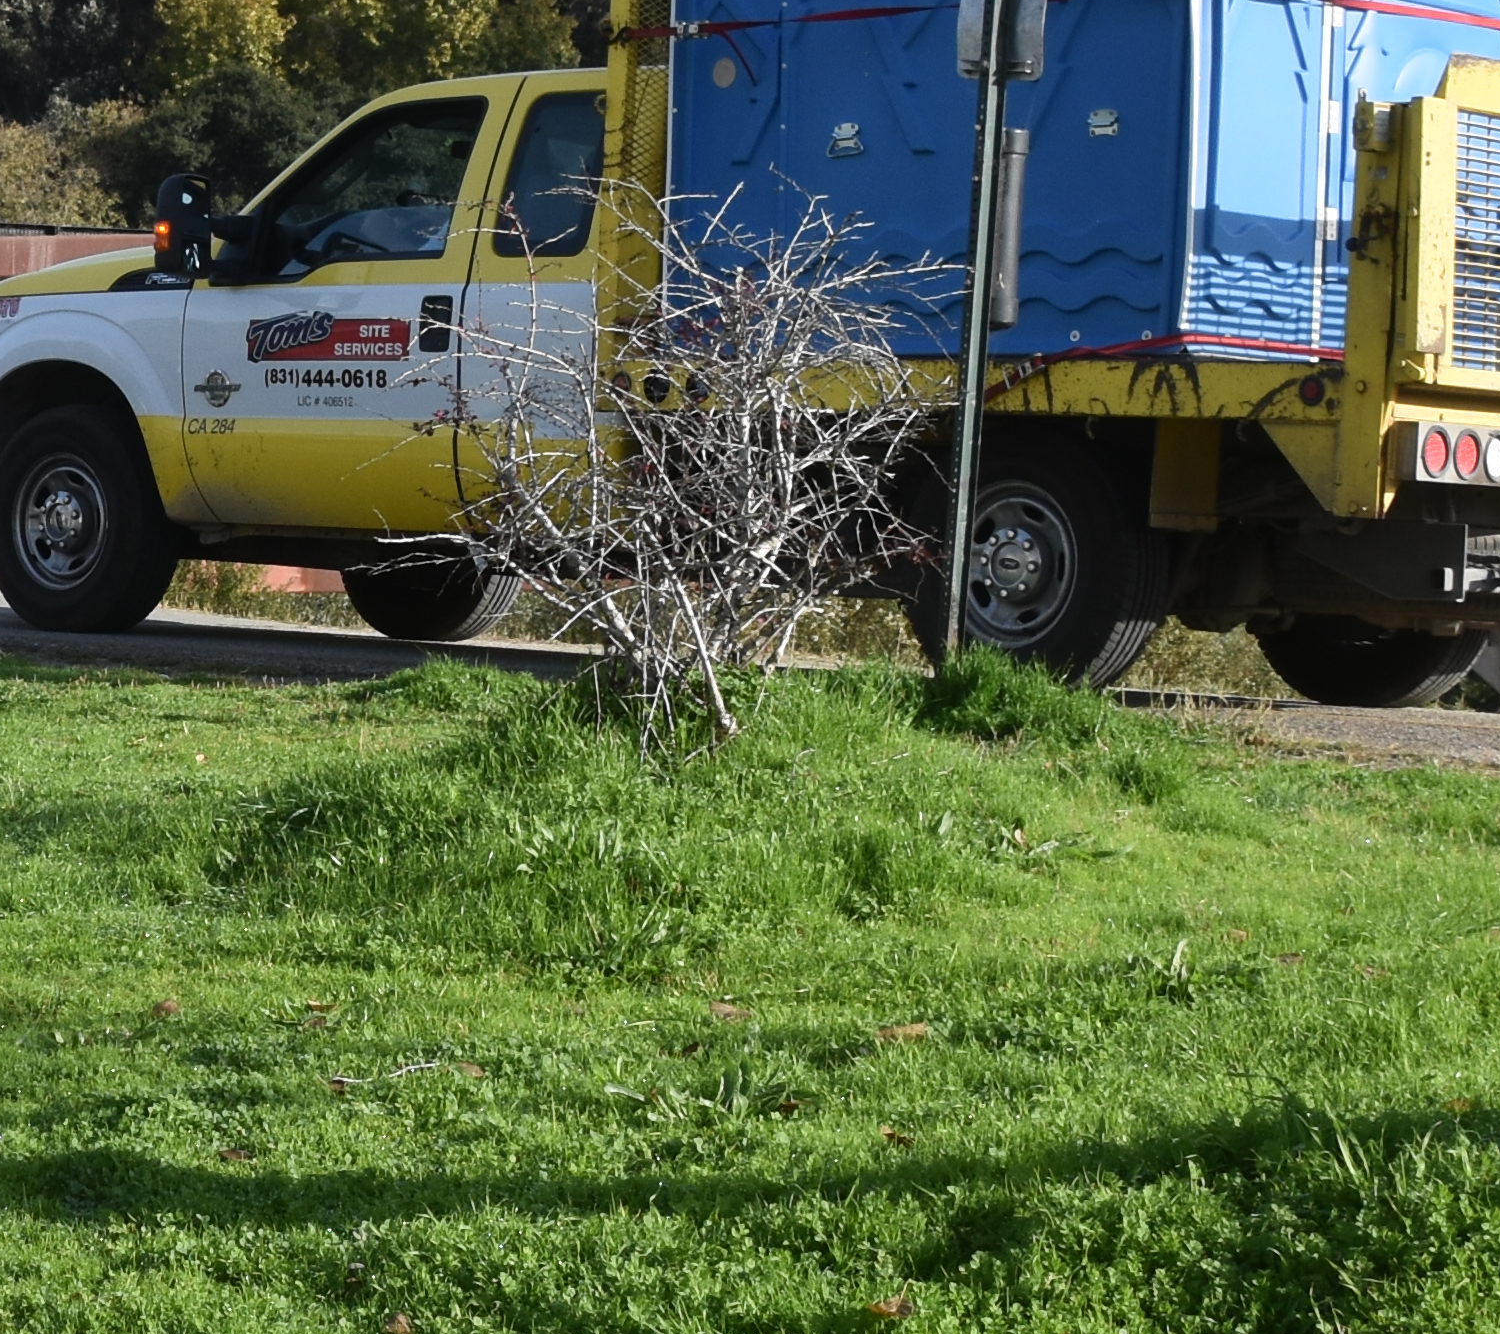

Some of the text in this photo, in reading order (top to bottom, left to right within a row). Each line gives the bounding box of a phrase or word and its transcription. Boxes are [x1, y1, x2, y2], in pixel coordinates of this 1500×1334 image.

[246, 310, 334, 363] Tom's
[359, 325, 390, 337] SITE
[334, 343, 403, 355] SERVICES
[297, 396, 311, 407] LIC
[188, 418, 236, 434] CA 284
